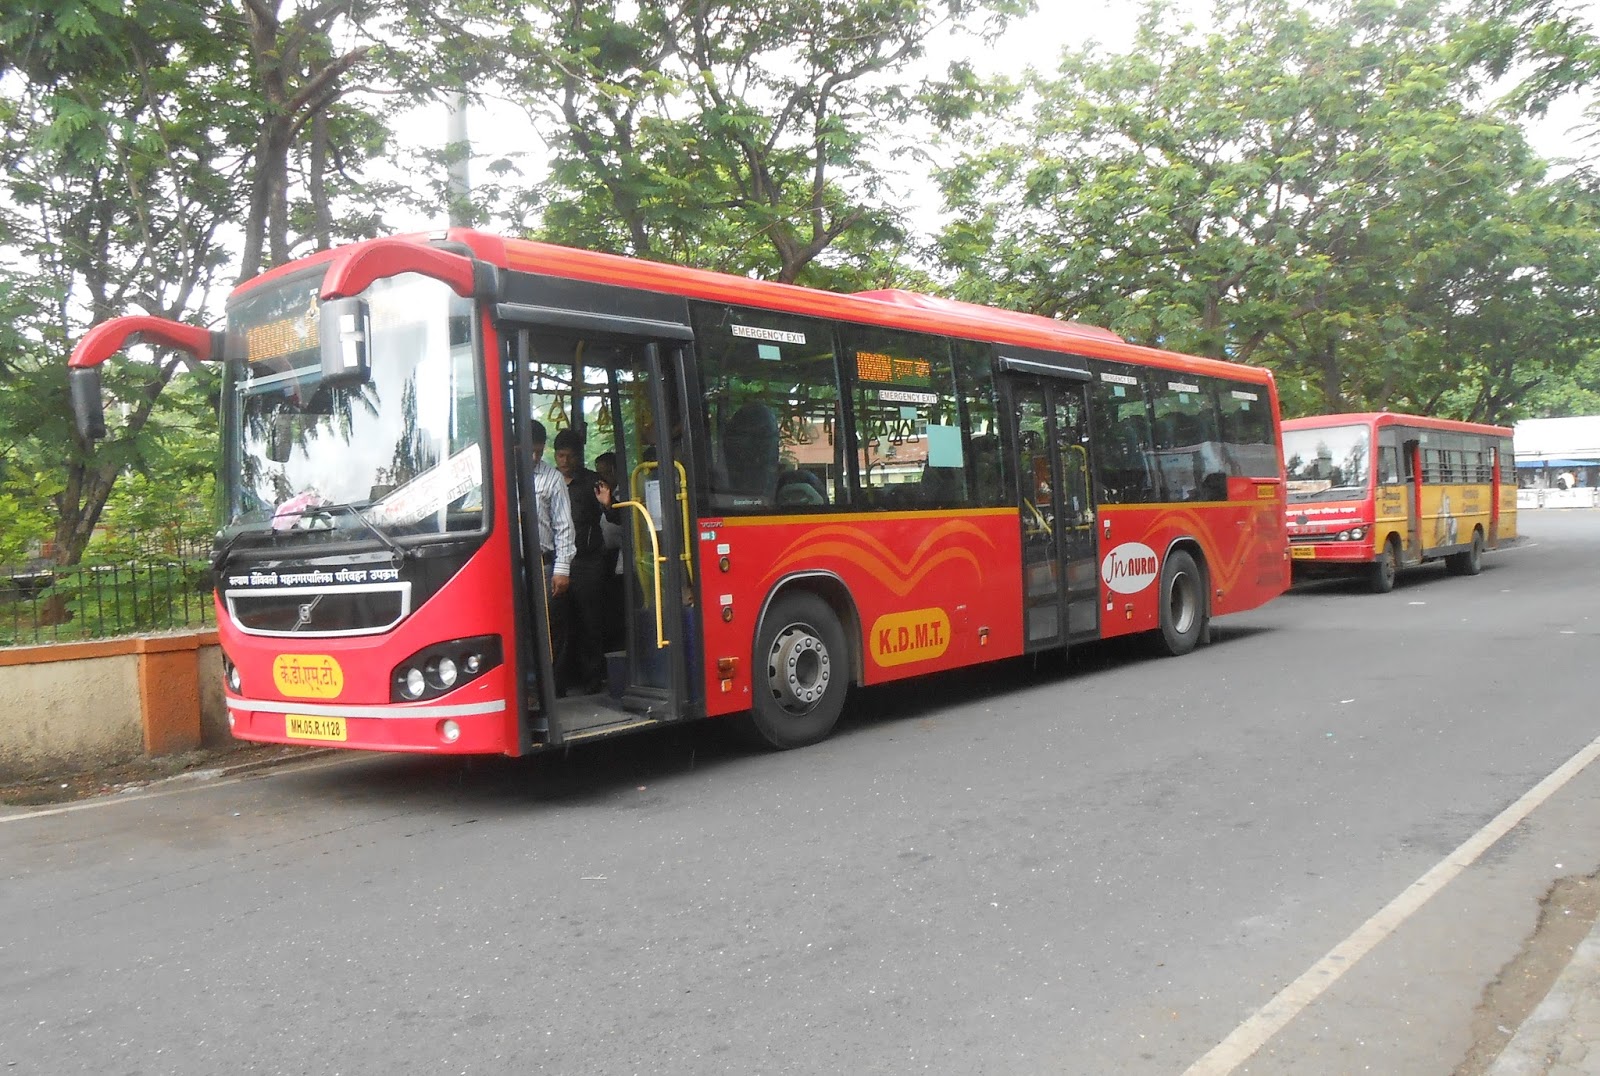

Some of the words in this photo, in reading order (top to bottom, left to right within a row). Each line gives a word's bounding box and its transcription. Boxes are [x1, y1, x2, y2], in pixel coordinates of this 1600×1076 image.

[732, 325, 784, 340] EMERGENCY
[786, 333, 804, 343] EXIT
[880, 391, 920, 402] EMERGENCY
[922, 395, 936, 403] EXIT
[335, 568, 367, 583] परिवहन
[369, 569, 399, 581] उपक्रम
[879, 621, 944, 655] K.D.M.T.
[290, 719, 341, 736] MH.05.R.1128
